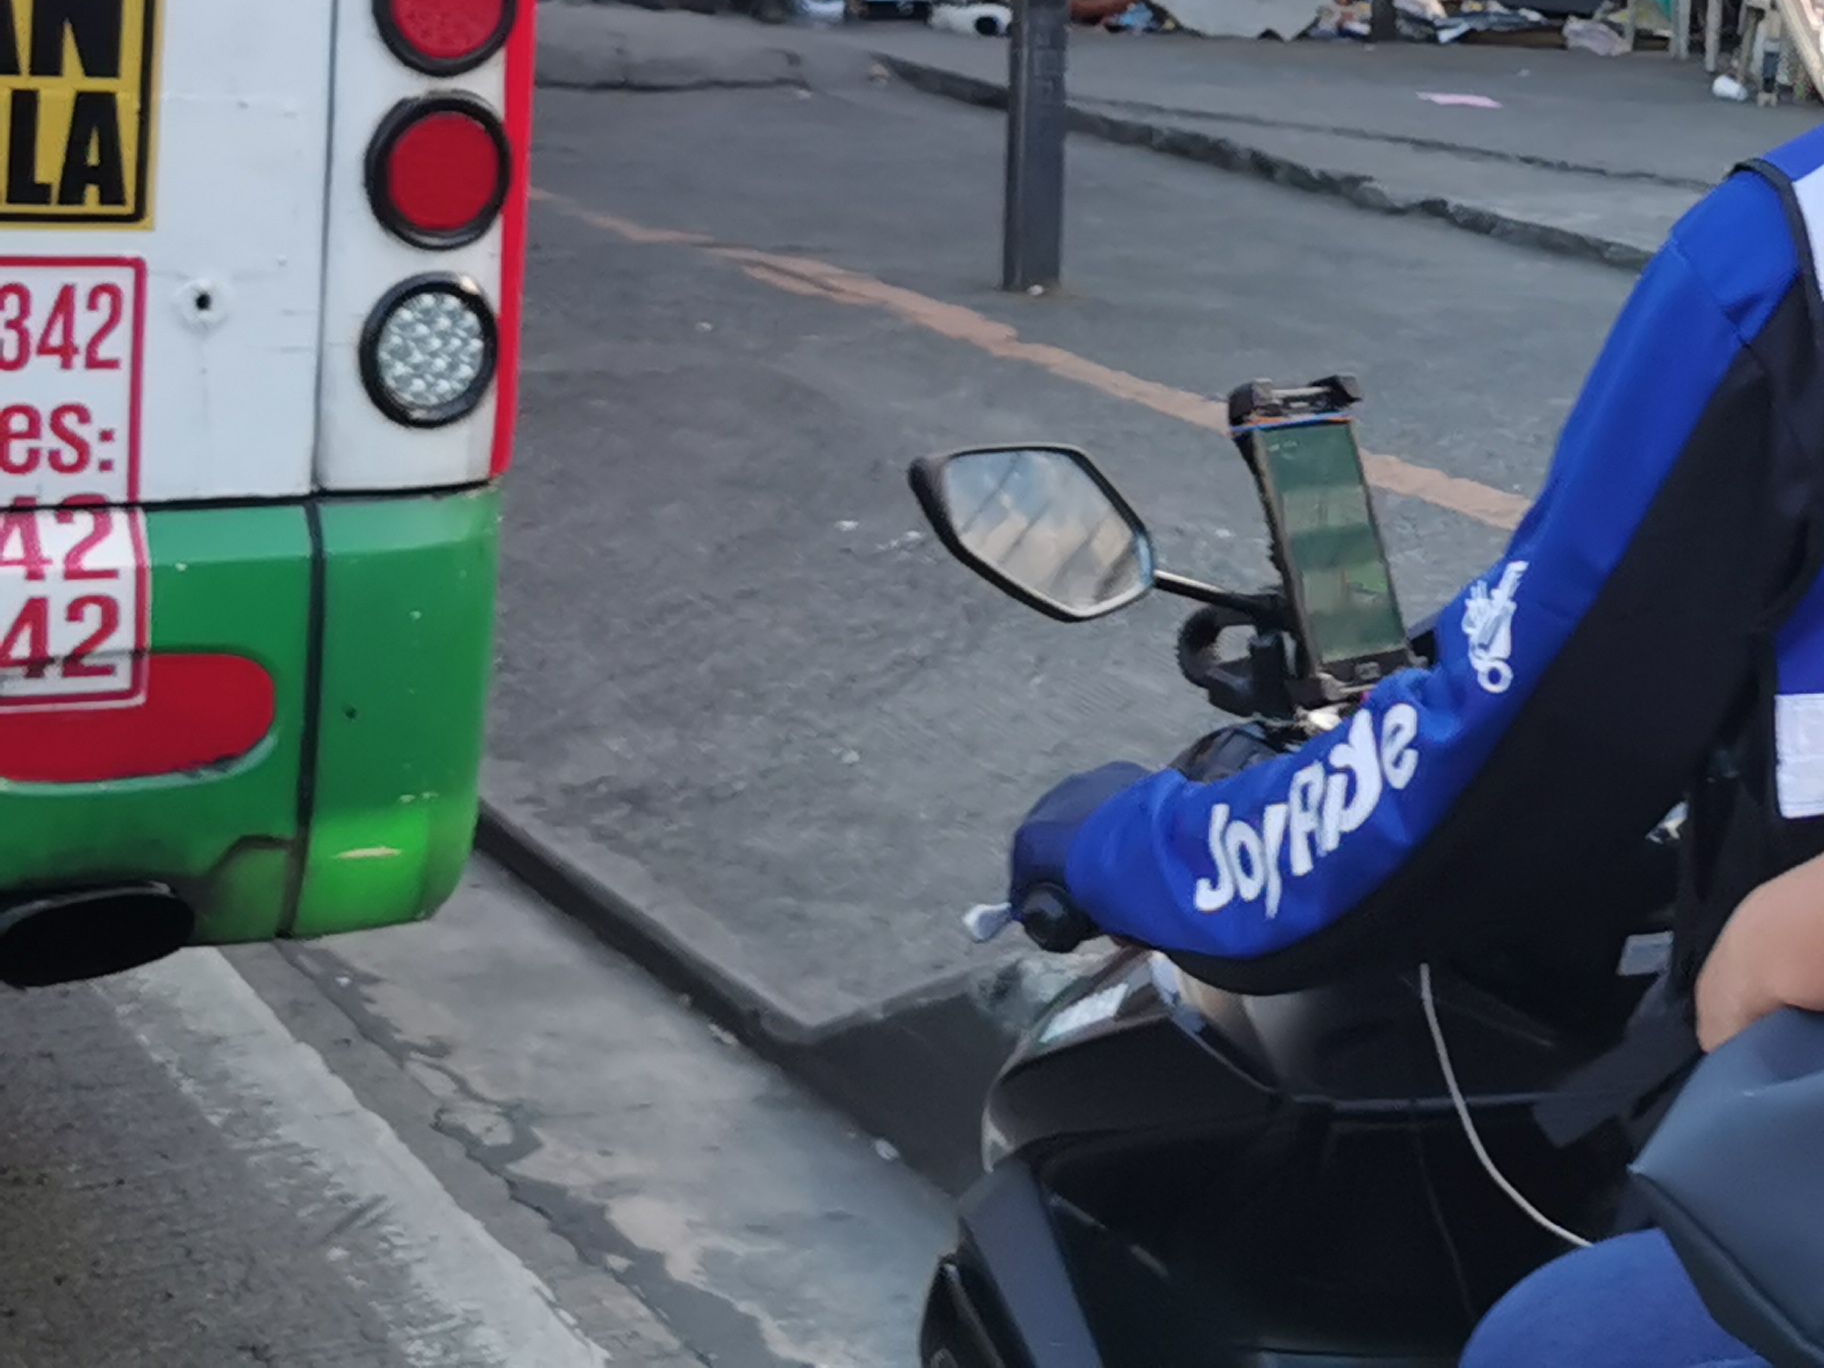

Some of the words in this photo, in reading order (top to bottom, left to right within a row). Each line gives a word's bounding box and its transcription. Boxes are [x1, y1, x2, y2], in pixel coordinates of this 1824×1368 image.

[0, 282, 124, 371] 342
[0, 403, 115, 475] es:
[0, 493, 120, 581] 42
[1195, 703, 1419, 919] JoyRide
